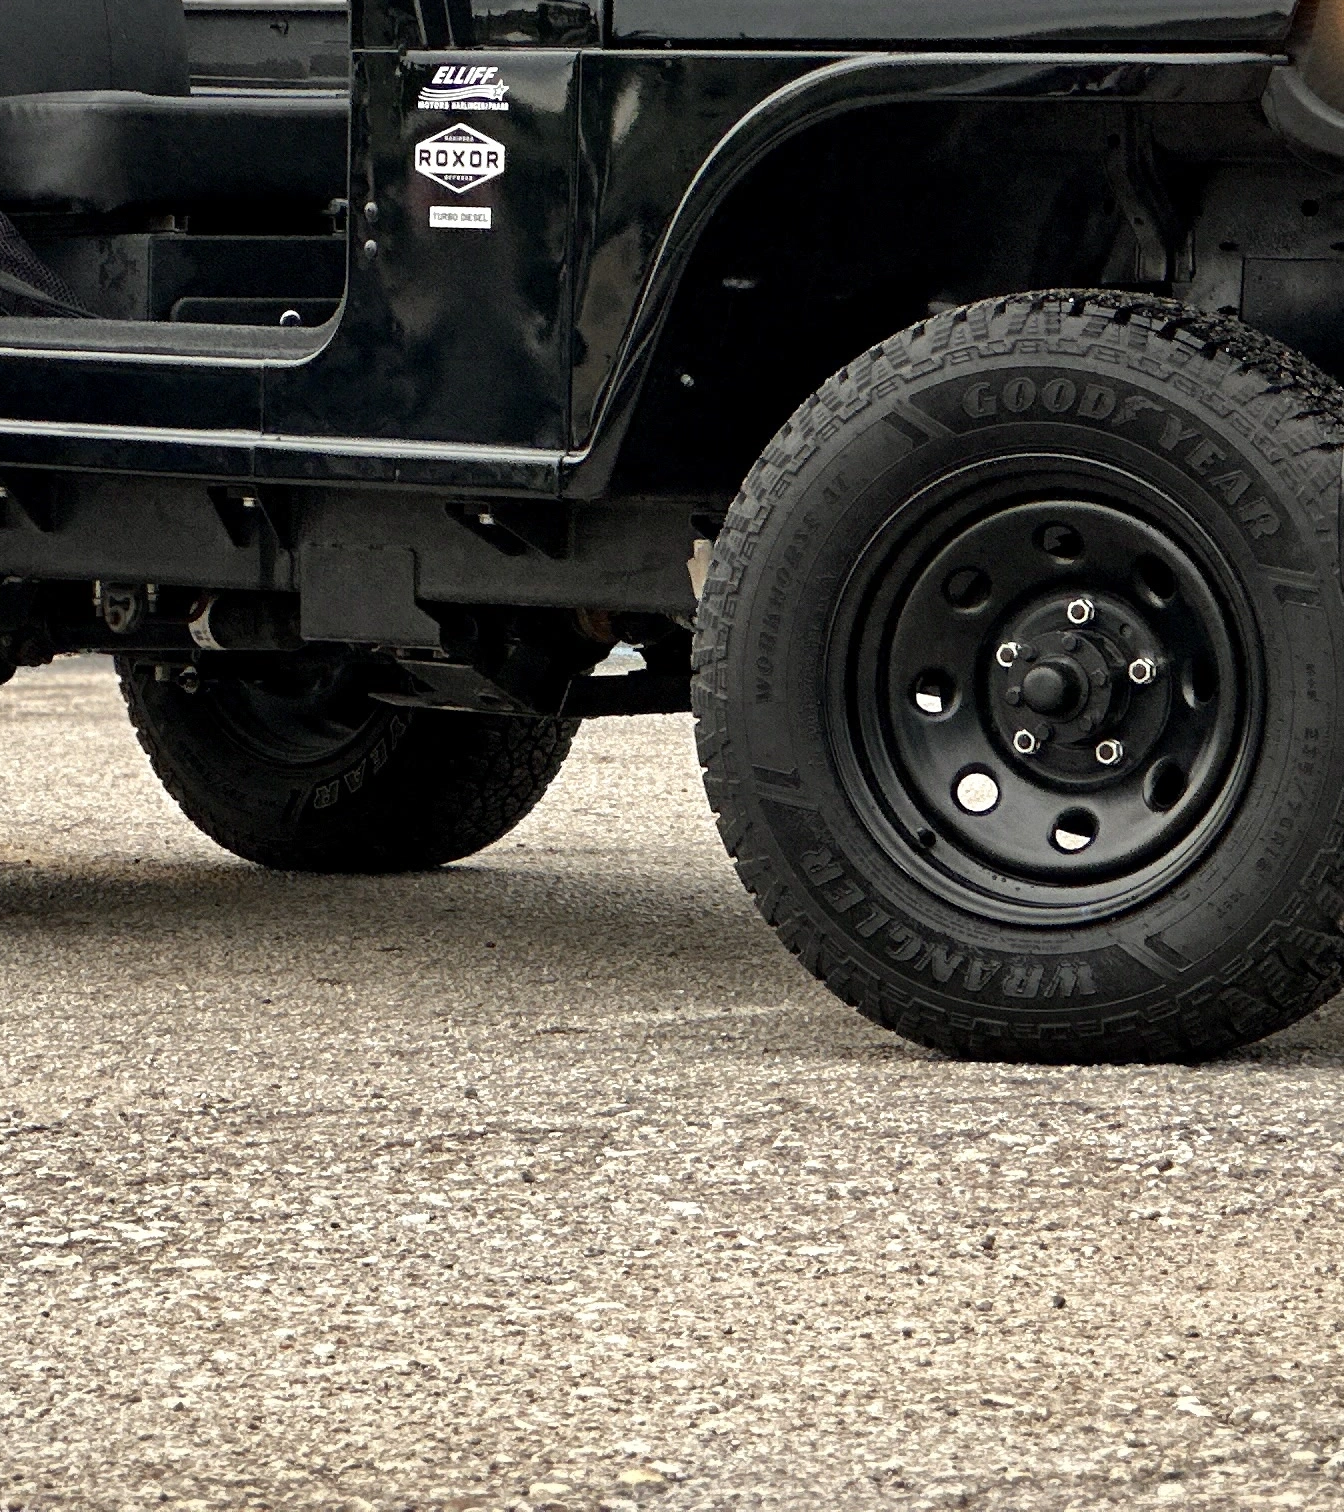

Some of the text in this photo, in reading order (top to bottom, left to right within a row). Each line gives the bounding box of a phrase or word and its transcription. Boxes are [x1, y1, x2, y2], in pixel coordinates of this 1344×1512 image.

[431, 65, 499, 86] ELLIFF
[418, 148, 499, 169] ROXOR
[802, 845, 1098, 1000] WRANGLER
